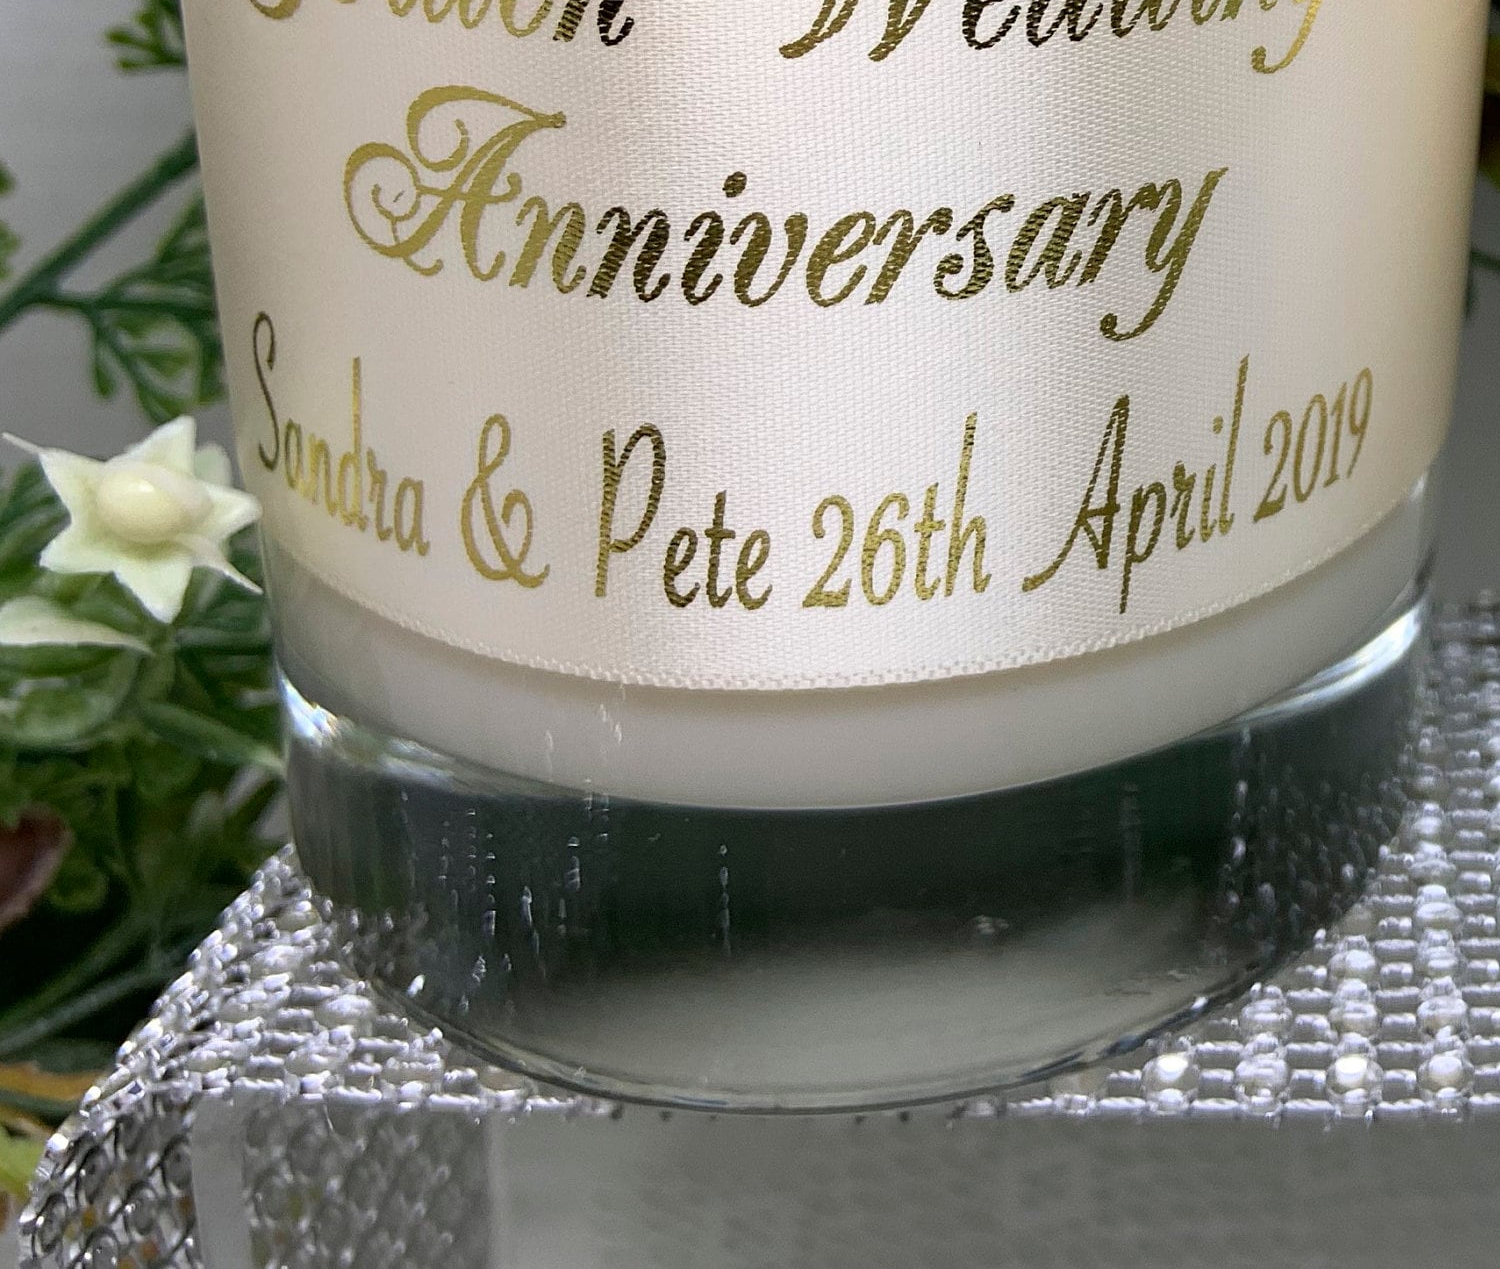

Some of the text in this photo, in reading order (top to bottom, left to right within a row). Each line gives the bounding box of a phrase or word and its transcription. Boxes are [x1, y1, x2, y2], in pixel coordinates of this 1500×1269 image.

[343, 84, 1230, 342] Anniversary
[251, 310, 1375, 615] Sandra & Pete 26th April 2019
